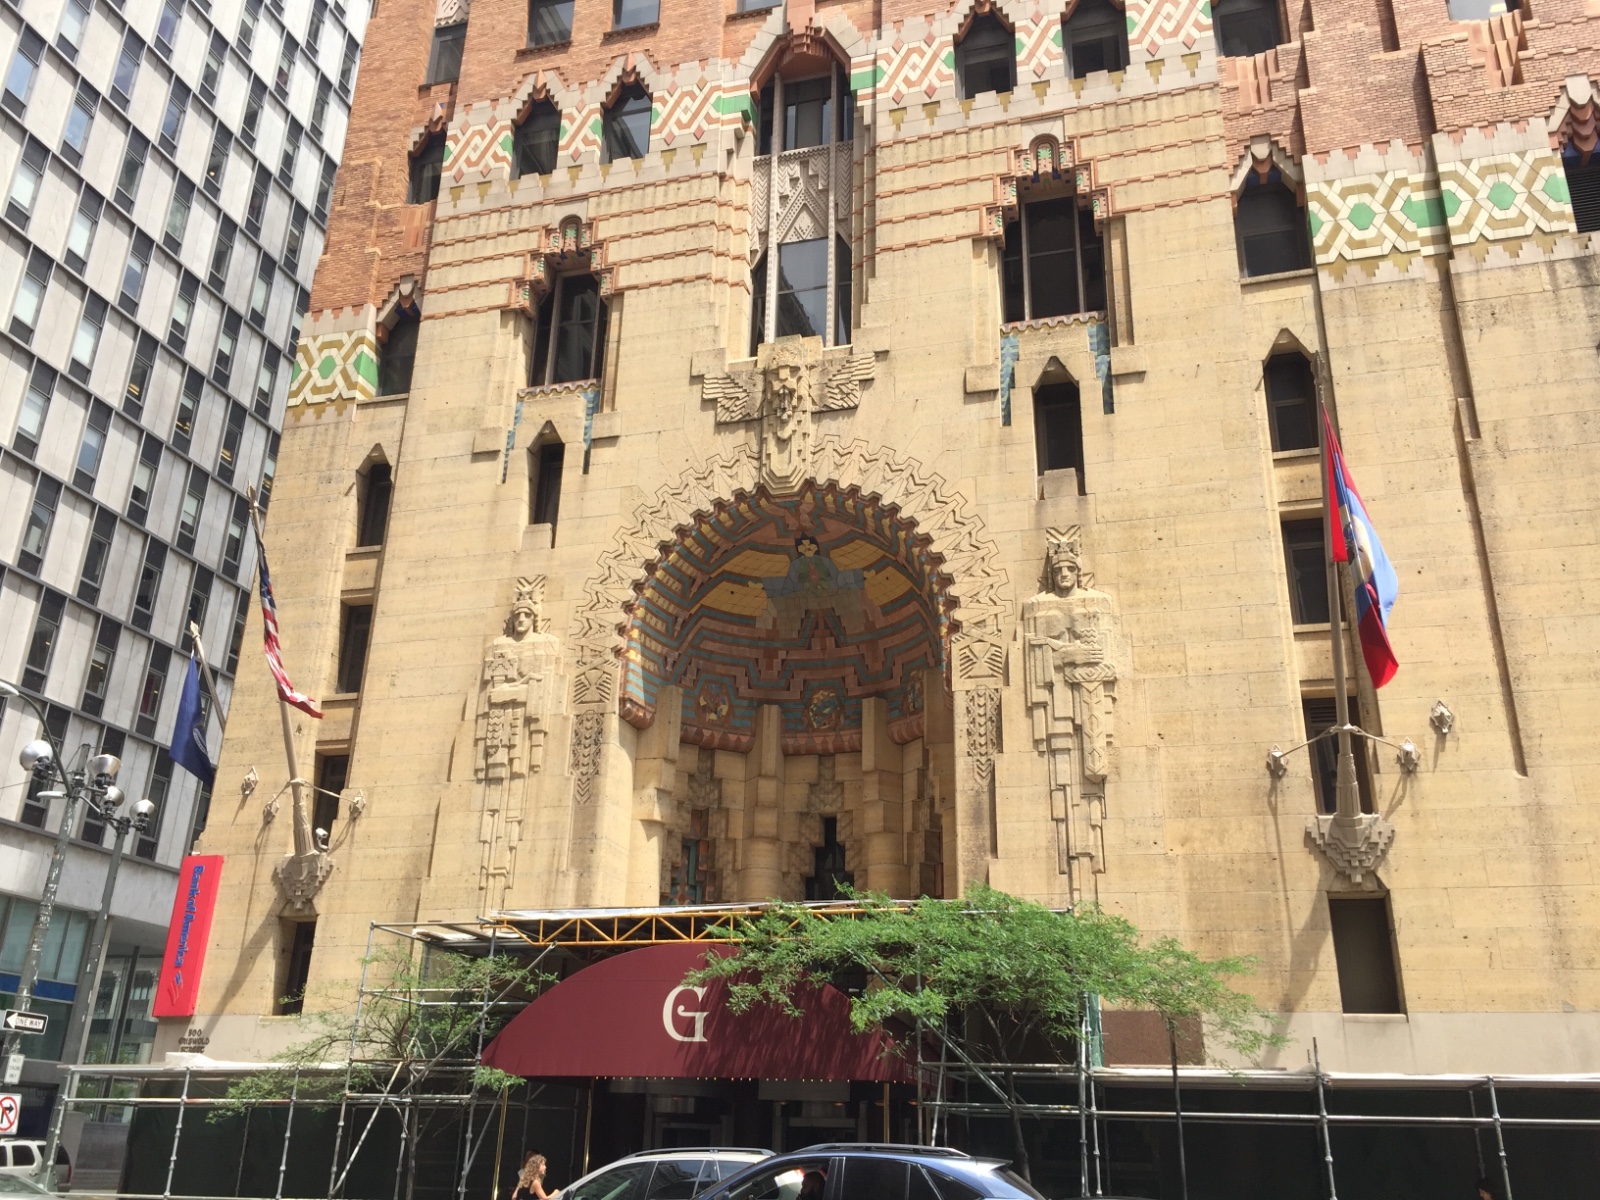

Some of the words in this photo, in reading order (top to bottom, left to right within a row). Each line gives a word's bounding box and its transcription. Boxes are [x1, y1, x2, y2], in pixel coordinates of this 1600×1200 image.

[188, 865, 205, 898] Bank
[185, 898, 197, 912] of
[174, 913, 196, 968] America
[15, 1017, 28, 1025] ONE
[29, 1019, 42, 1028] WAY
[662, 985, 709, 1042] G
[187, 1029, 203, 1037] 500
